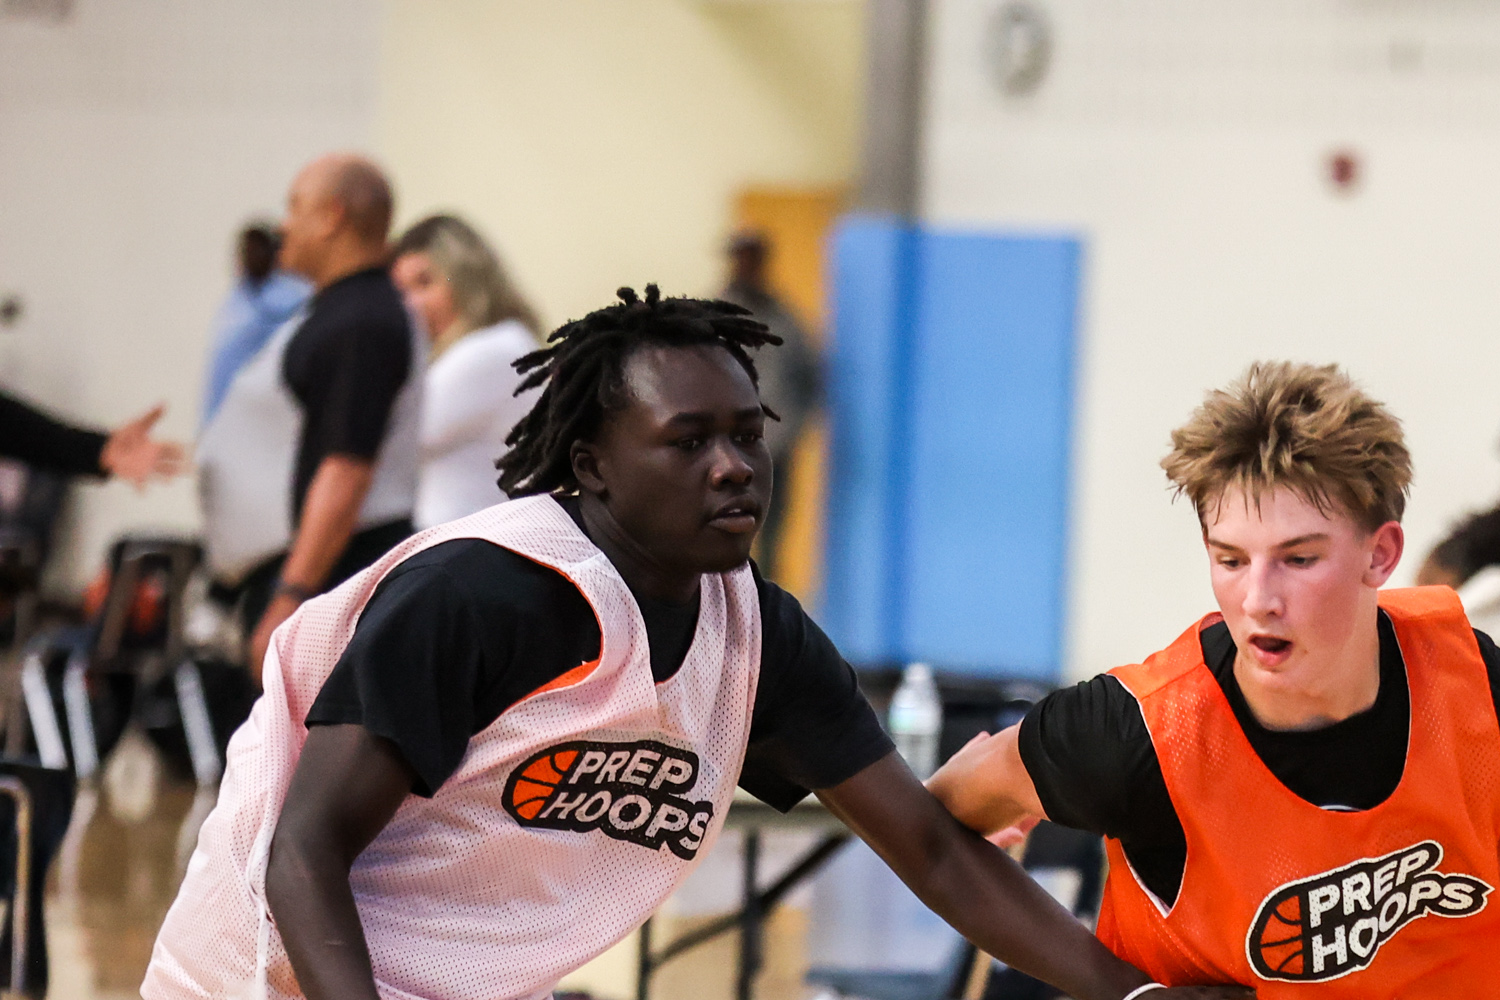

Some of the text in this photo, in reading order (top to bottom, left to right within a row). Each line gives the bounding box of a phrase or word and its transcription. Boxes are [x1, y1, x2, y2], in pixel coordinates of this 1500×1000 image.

[568, 749, 693, 790] PREP
[538, 790, 710, 850] HOOPS
[1308, 850, 1430, 928] PREP
[1312, 879, 1476, 973] HOOPS
